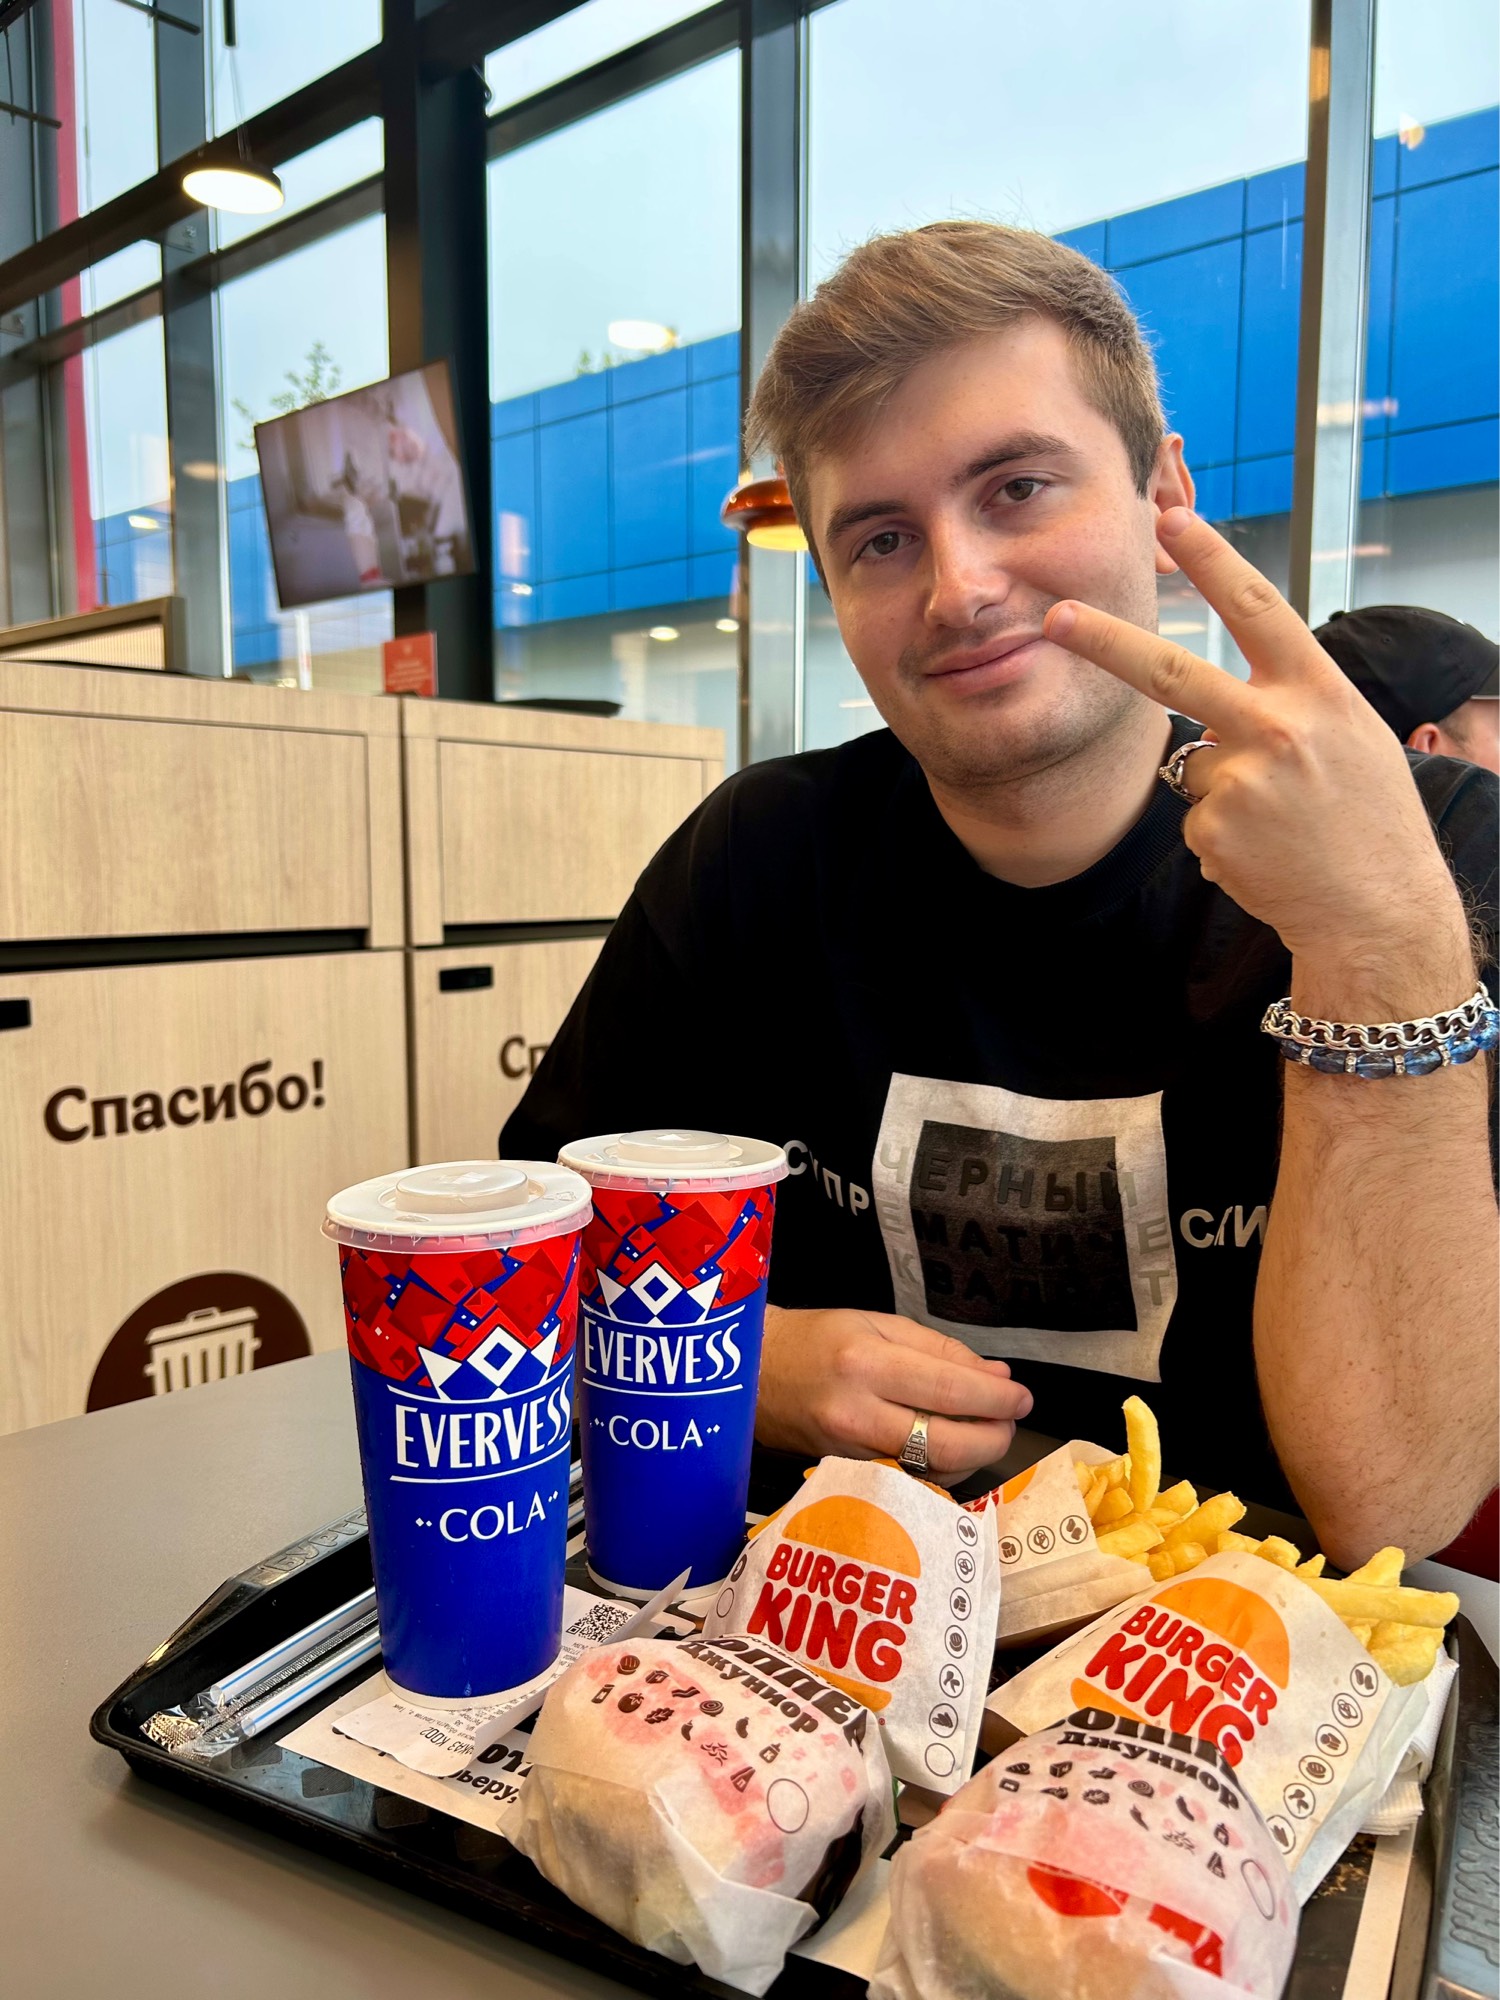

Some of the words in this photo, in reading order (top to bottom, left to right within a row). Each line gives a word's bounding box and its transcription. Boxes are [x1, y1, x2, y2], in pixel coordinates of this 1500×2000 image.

[45, 1058, 325, 1142] Спасибо!
[880, 1142, 1137, 1212] ЧЕРНЫЙ
[583, 1316, 743, 1385] EVERVESS
[395, 1374, 571, 1468] EVERVESS
[608, 1415, 703, 1450] COLA
[439, 1491, 546, 1542] COLA
[766, 1543, 917, 1625] BURGER
[746, 1581, 906, 1683] KING
[1121, 1605, 1277, 1726] BURGER
[676, 1641, 819, 1733] Джуниор
[1085, 1633, 1255, 1768] KING
[1057, 1731, 1239, 1810] Джуниор
